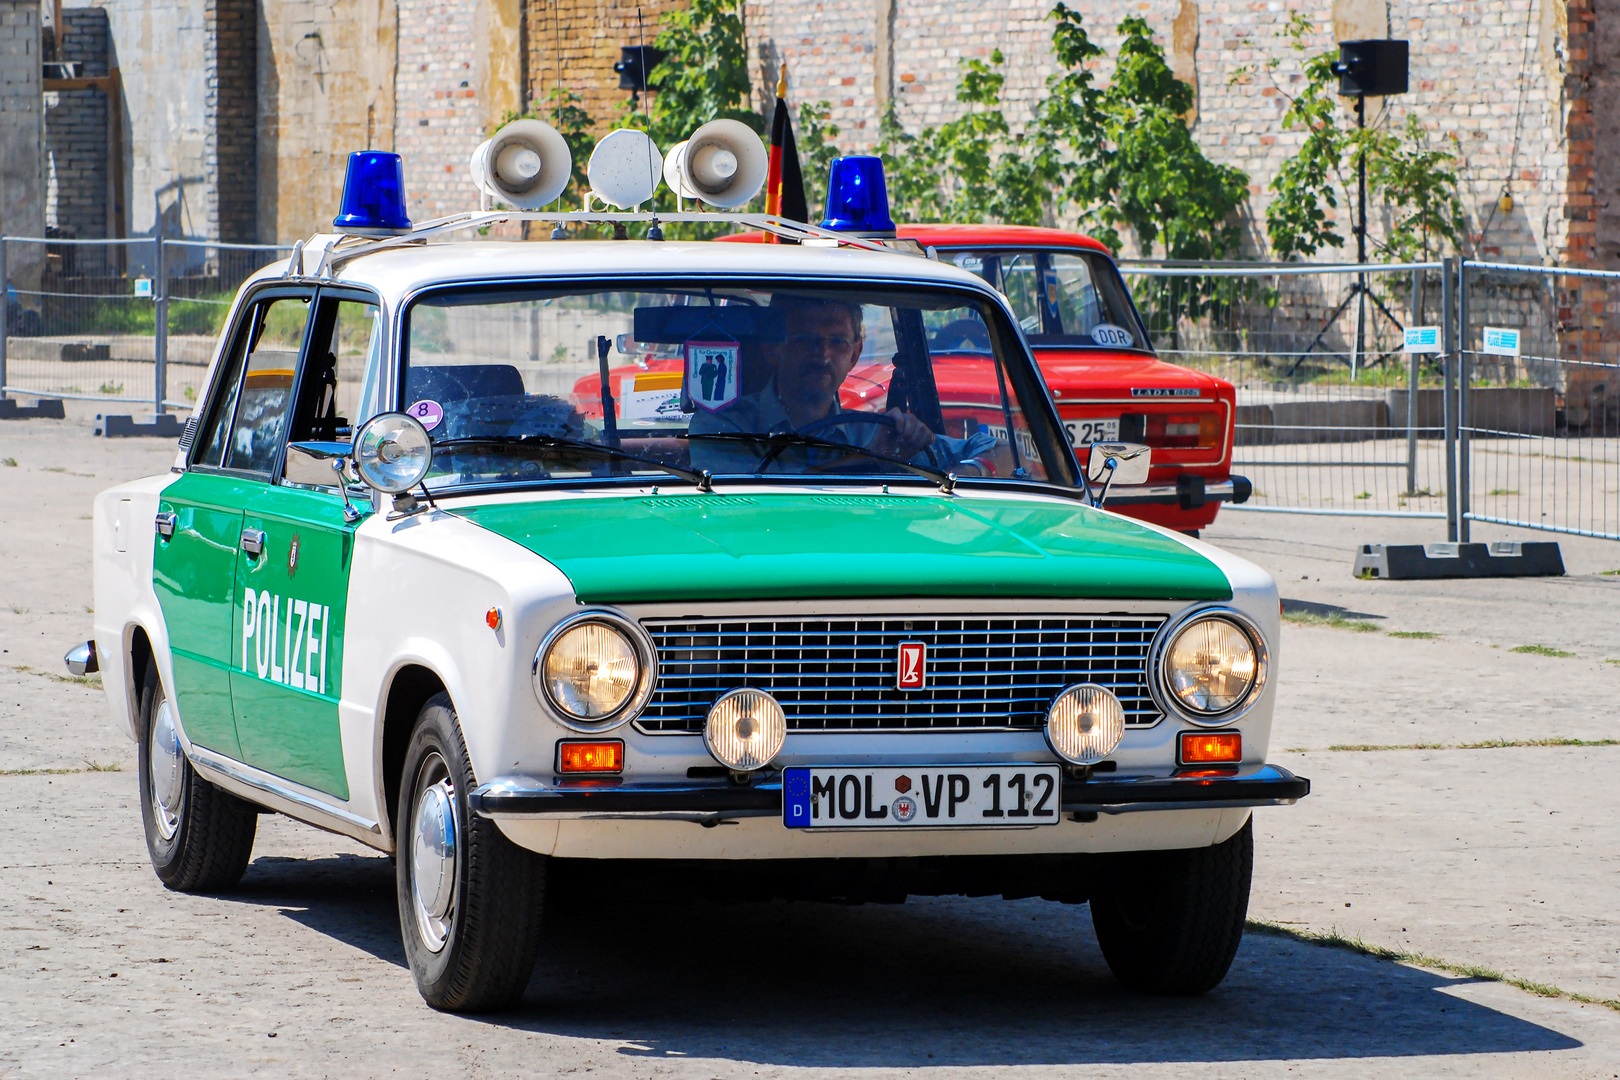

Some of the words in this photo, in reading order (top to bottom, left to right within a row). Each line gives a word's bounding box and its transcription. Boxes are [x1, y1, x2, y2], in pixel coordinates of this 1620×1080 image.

[1098, 329, 1128, 345] DDR
[1138, 388, 1171, 396] LADA
[418, 402, 428, 417] 8
[1080, 422, 1105, 445] 25
[242, 587, 330, 695] POLIZEI
[812, 775, 888, 820] MOL
[921, 774, 970, 818] VP
[982, 773, 1055, 818] 112
[793, 804, 803, 817] D
